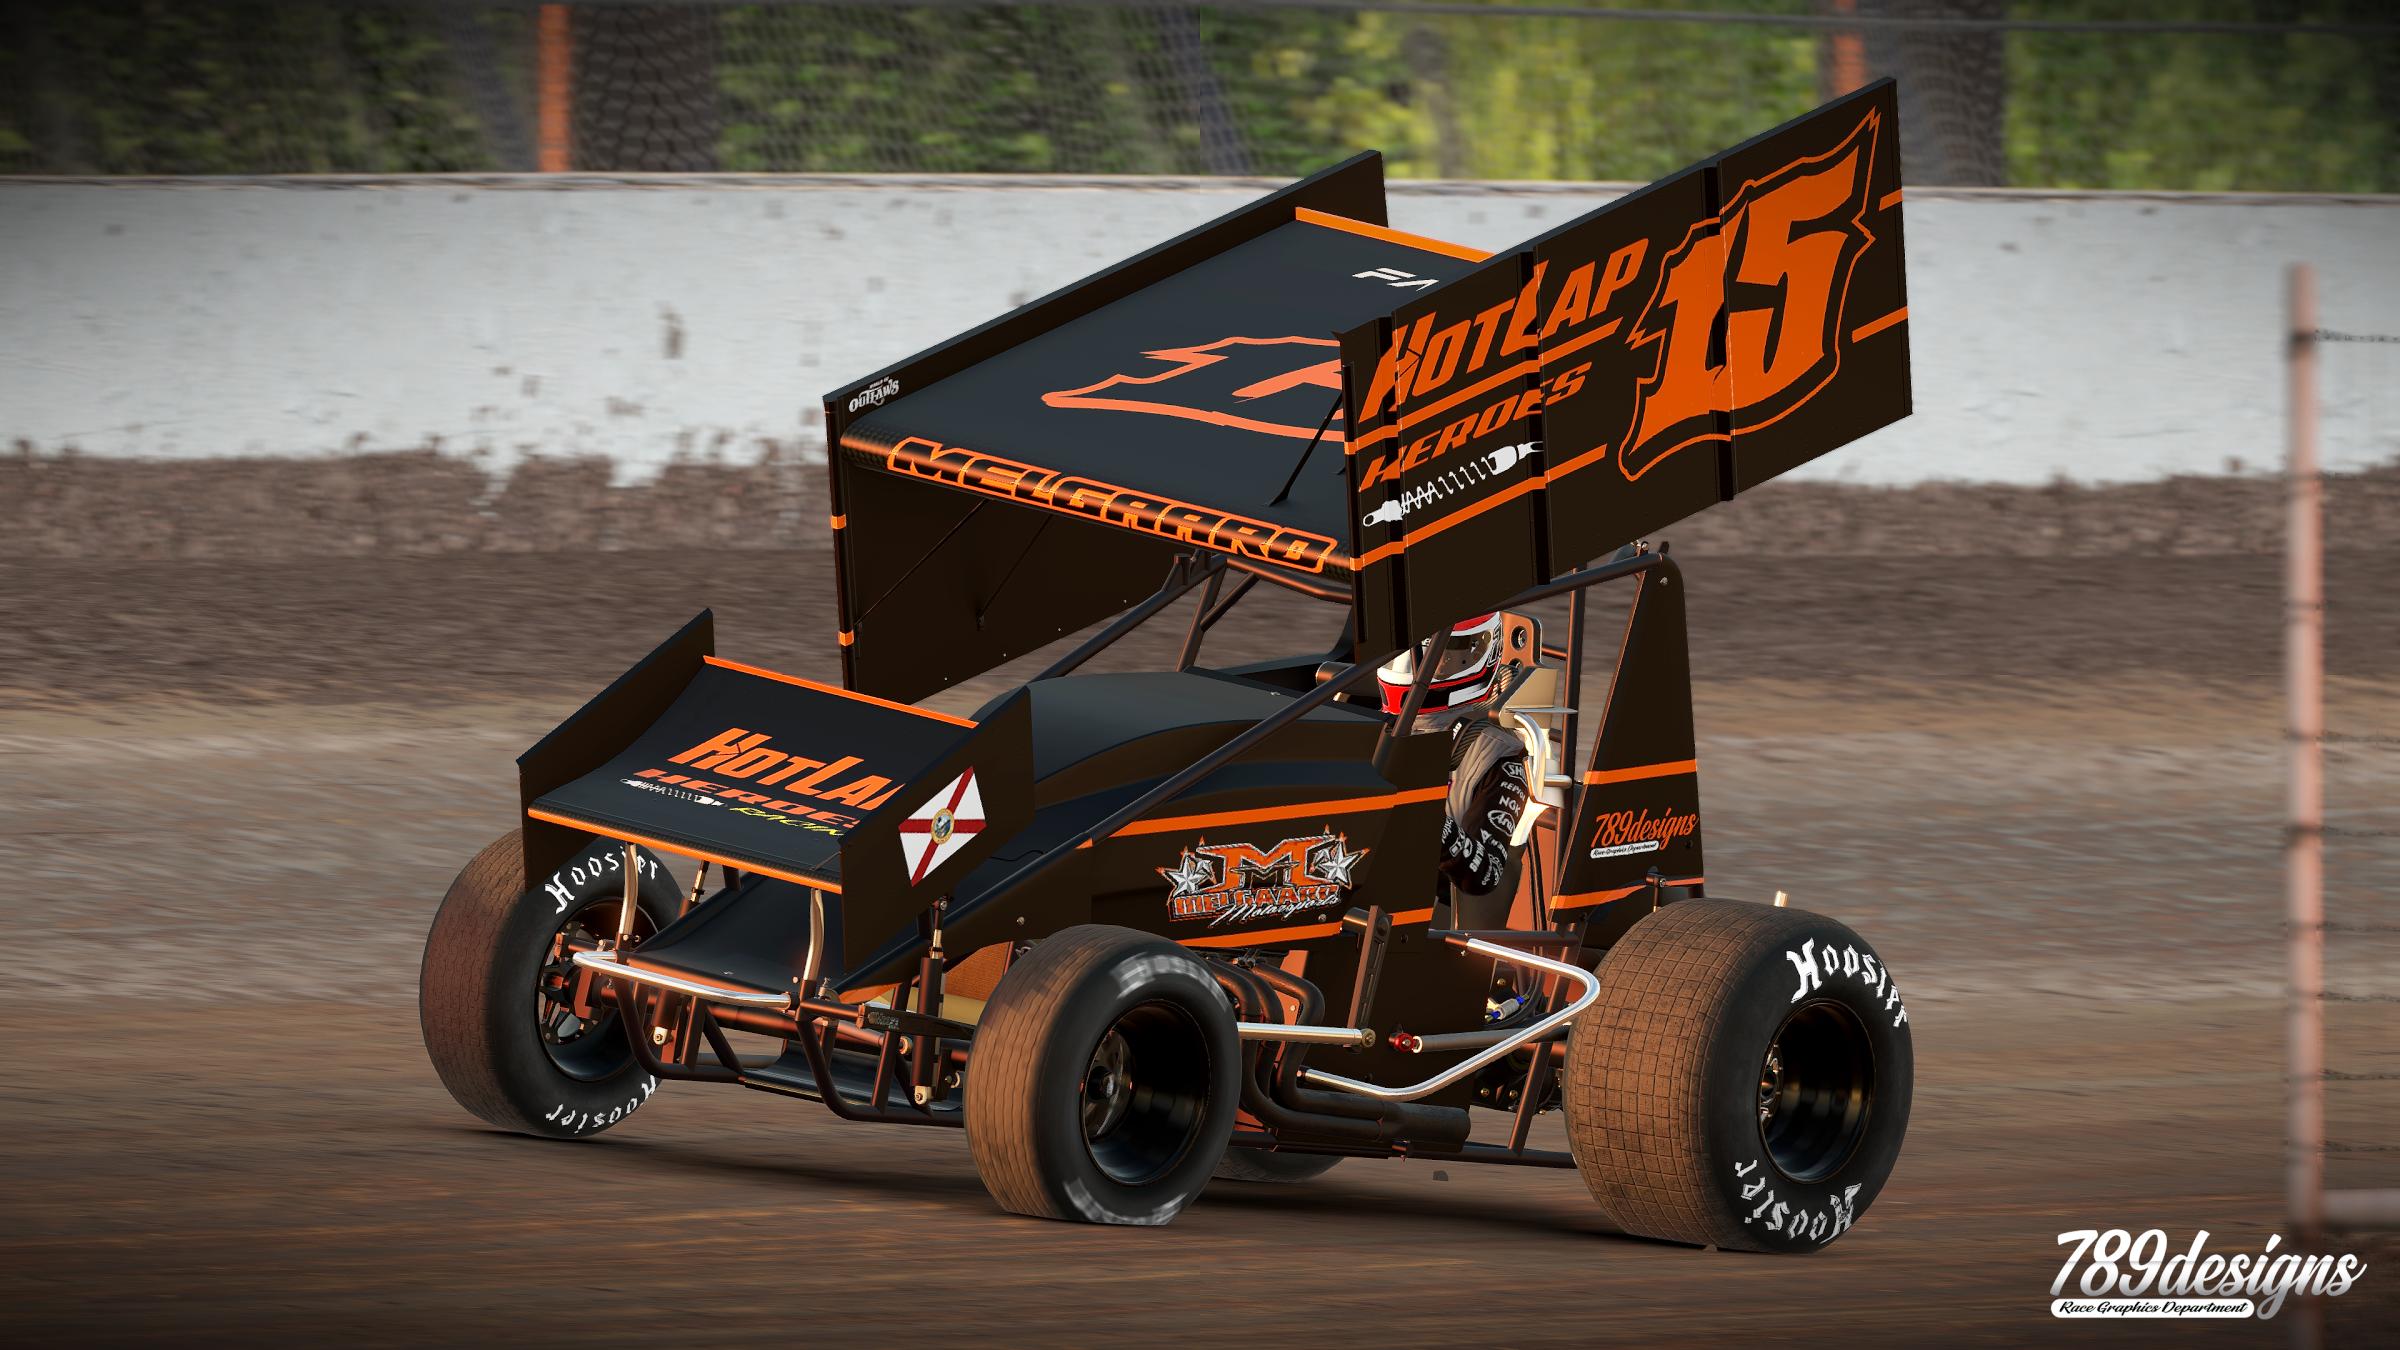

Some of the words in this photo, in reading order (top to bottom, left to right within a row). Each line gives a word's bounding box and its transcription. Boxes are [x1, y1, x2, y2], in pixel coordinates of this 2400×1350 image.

[1629, 146, 1858, 455] 15
[1359, 361, 1593, 492] HEROES
[889, 437, 1338, 573] MELGAARD
[667, 727, 906, 811] HOTLA
[1499, 795, 1521, 816] NGK
[728, 807, 844, 836] RACIN
[1591, 807, 1699, 851] 789designs
[1735, 1160, 1862, 1245] Hoosier
